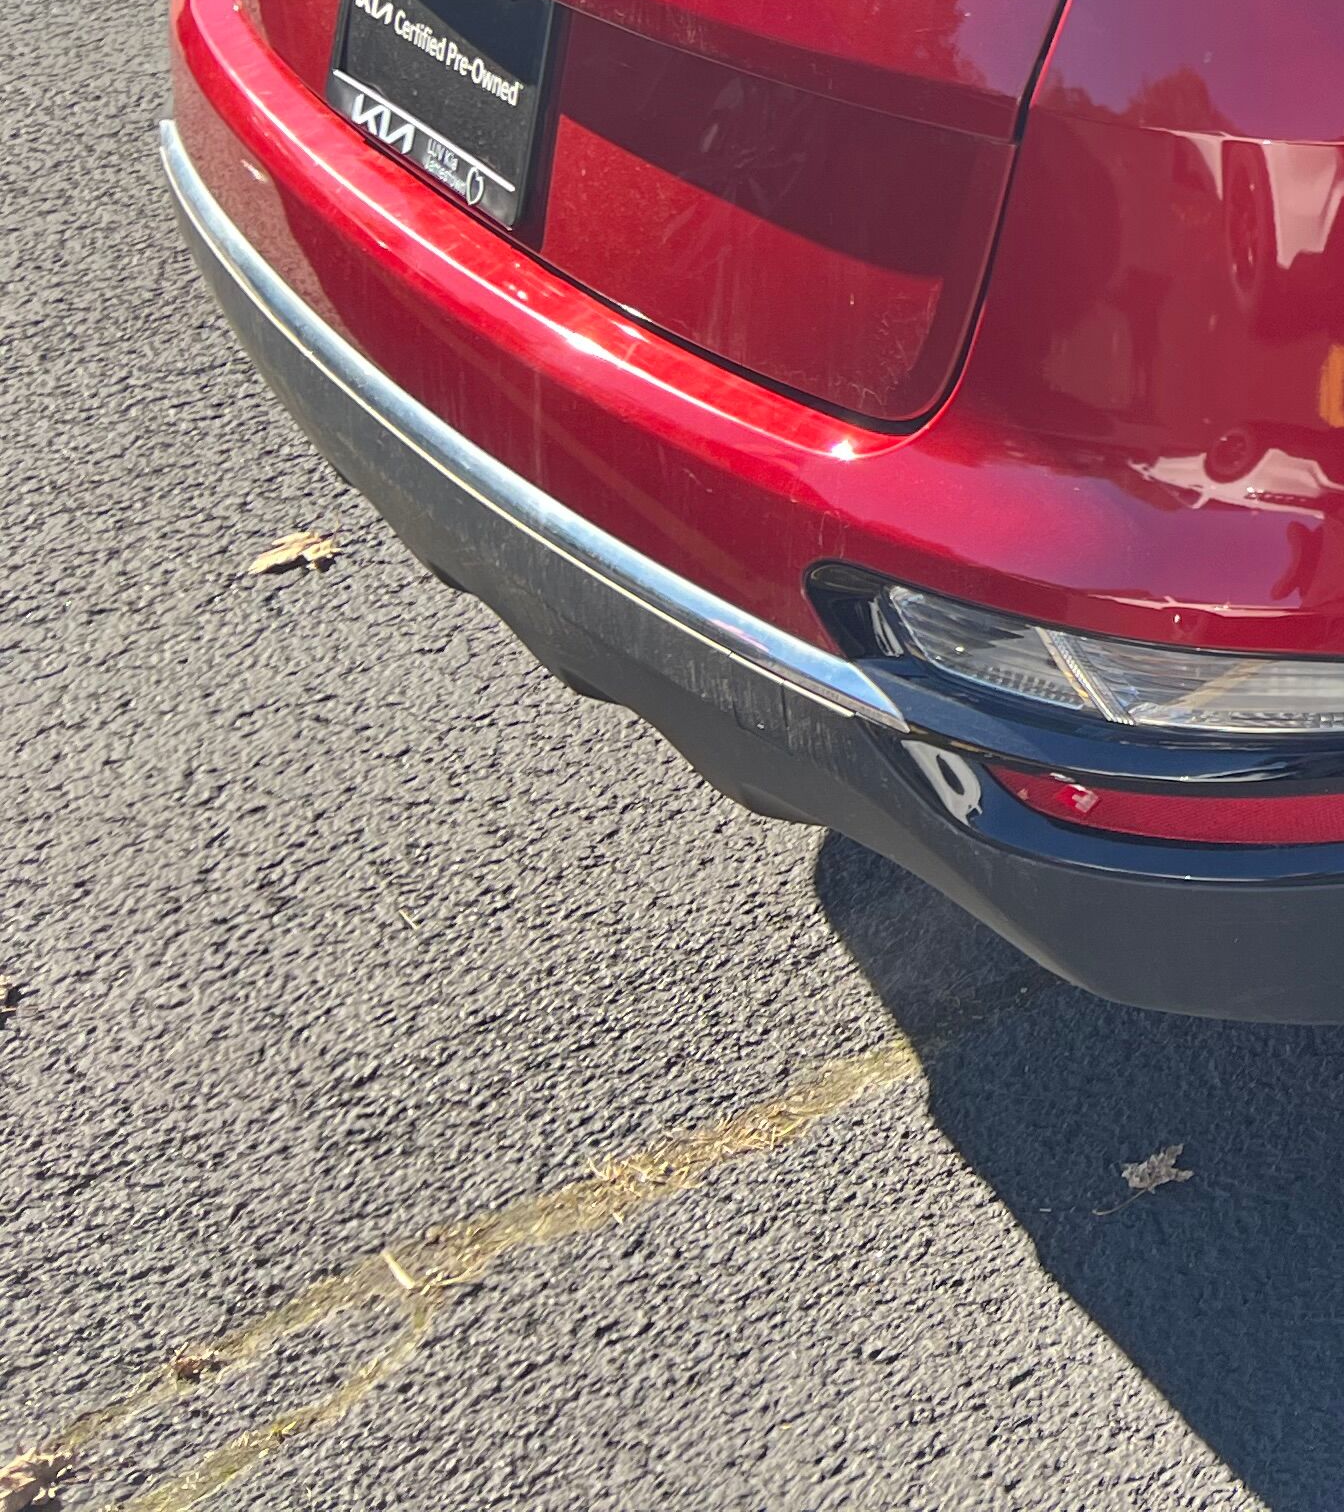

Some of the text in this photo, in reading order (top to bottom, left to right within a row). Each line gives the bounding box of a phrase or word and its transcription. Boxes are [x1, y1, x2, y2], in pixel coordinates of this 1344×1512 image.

[394, 9, 447, 62] Certified
[446, 42, 520, 107] Pre-Owned
[352, 94, 416, 155] KIA
